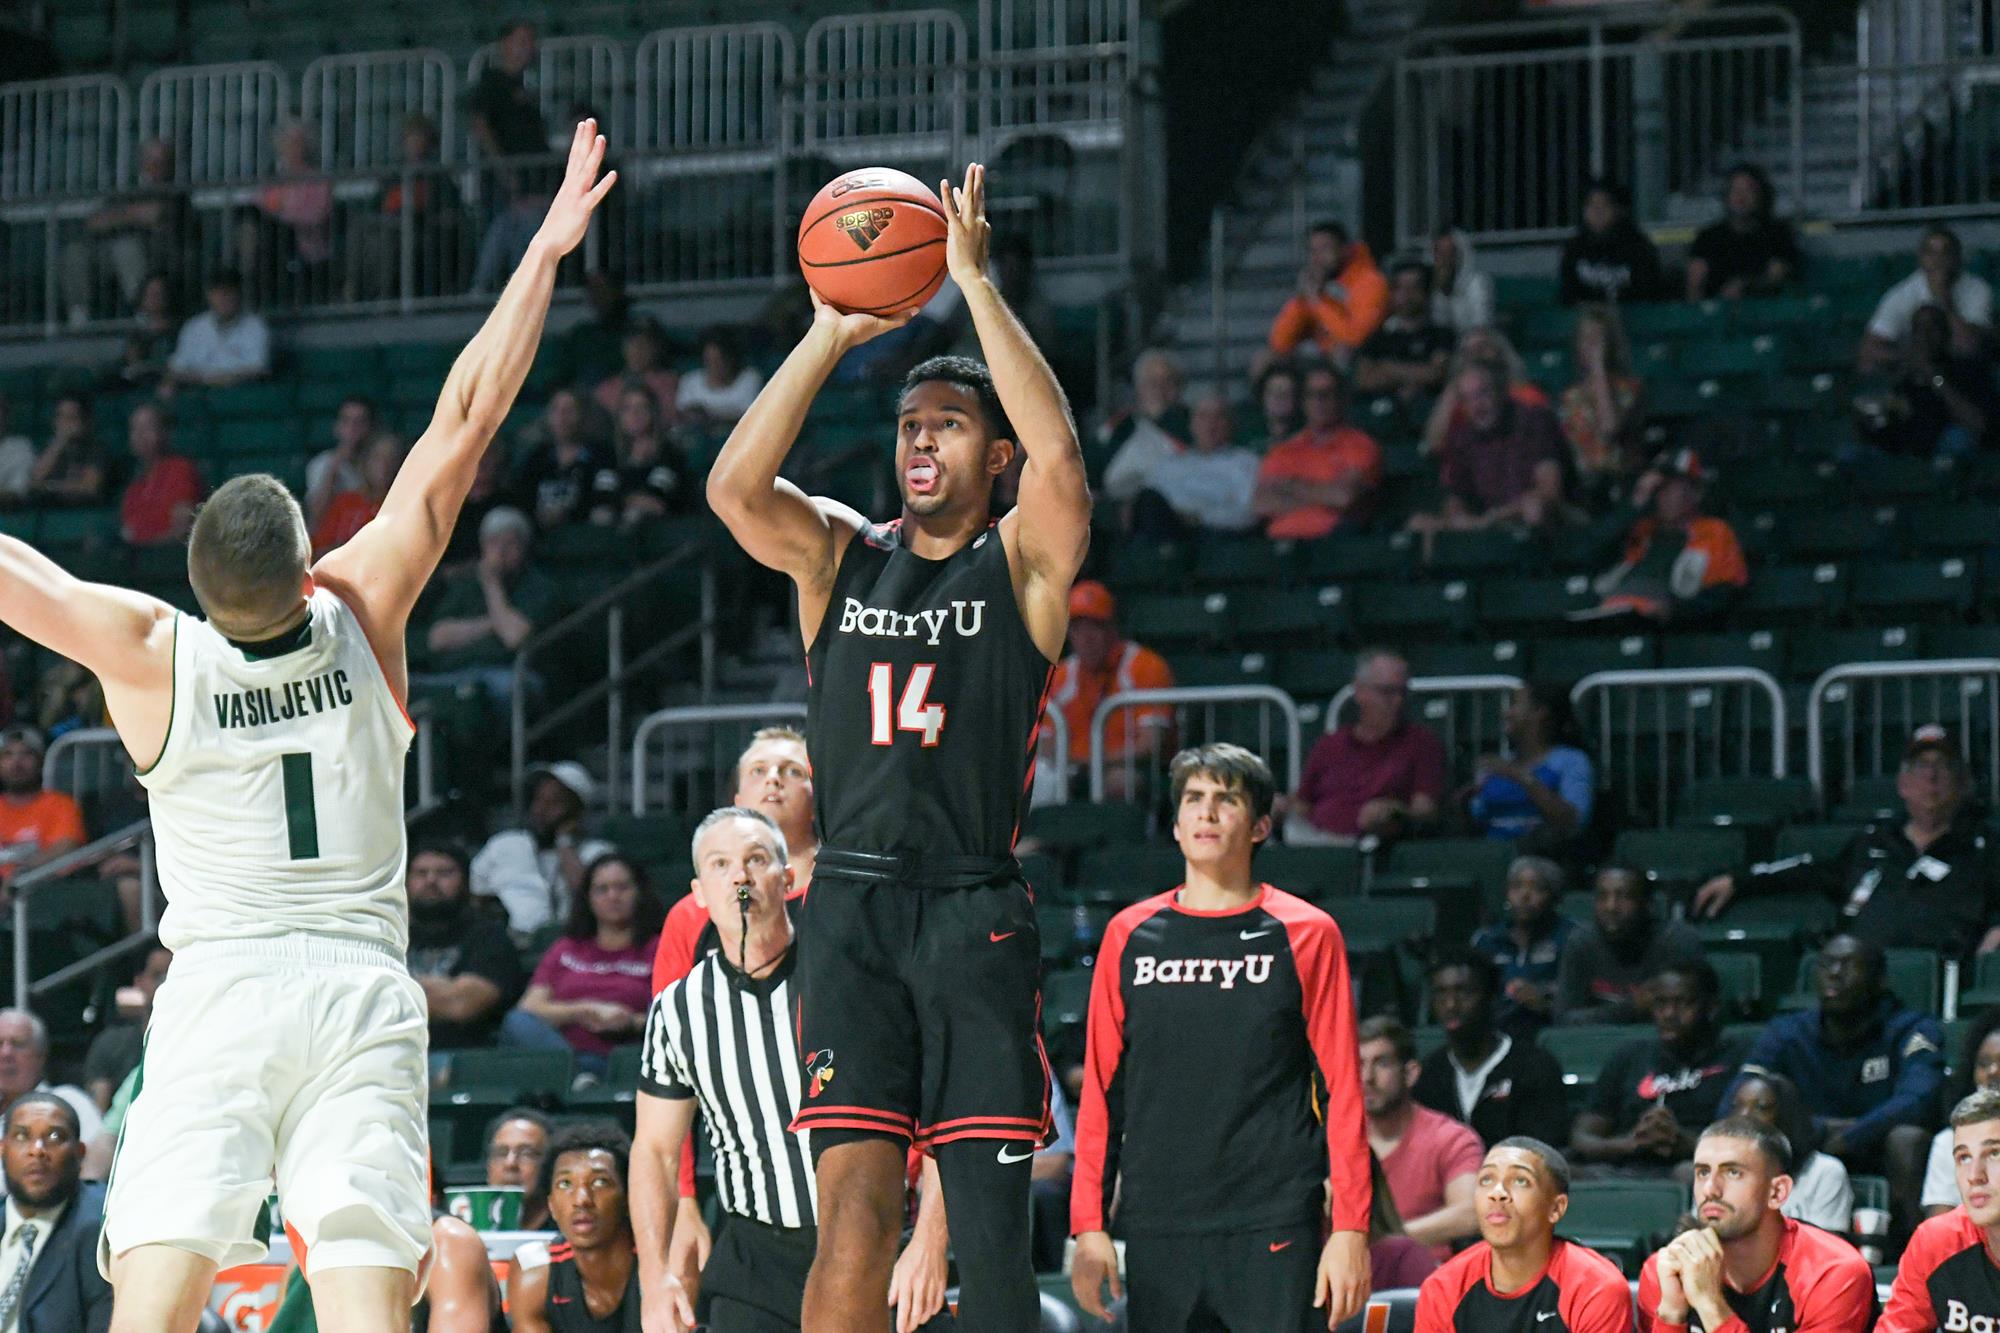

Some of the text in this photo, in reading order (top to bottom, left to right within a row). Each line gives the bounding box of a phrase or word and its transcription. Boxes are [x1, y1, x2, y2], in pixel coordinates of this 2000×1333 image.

[836, 207, 894, 229] adidas
[214, 669, 353, 729] VASILJEVIC
[867, 662, 947, 748] 14
[281, 752, 319, 861] 1
[1944, 1299, 2000, 1333] Ba
